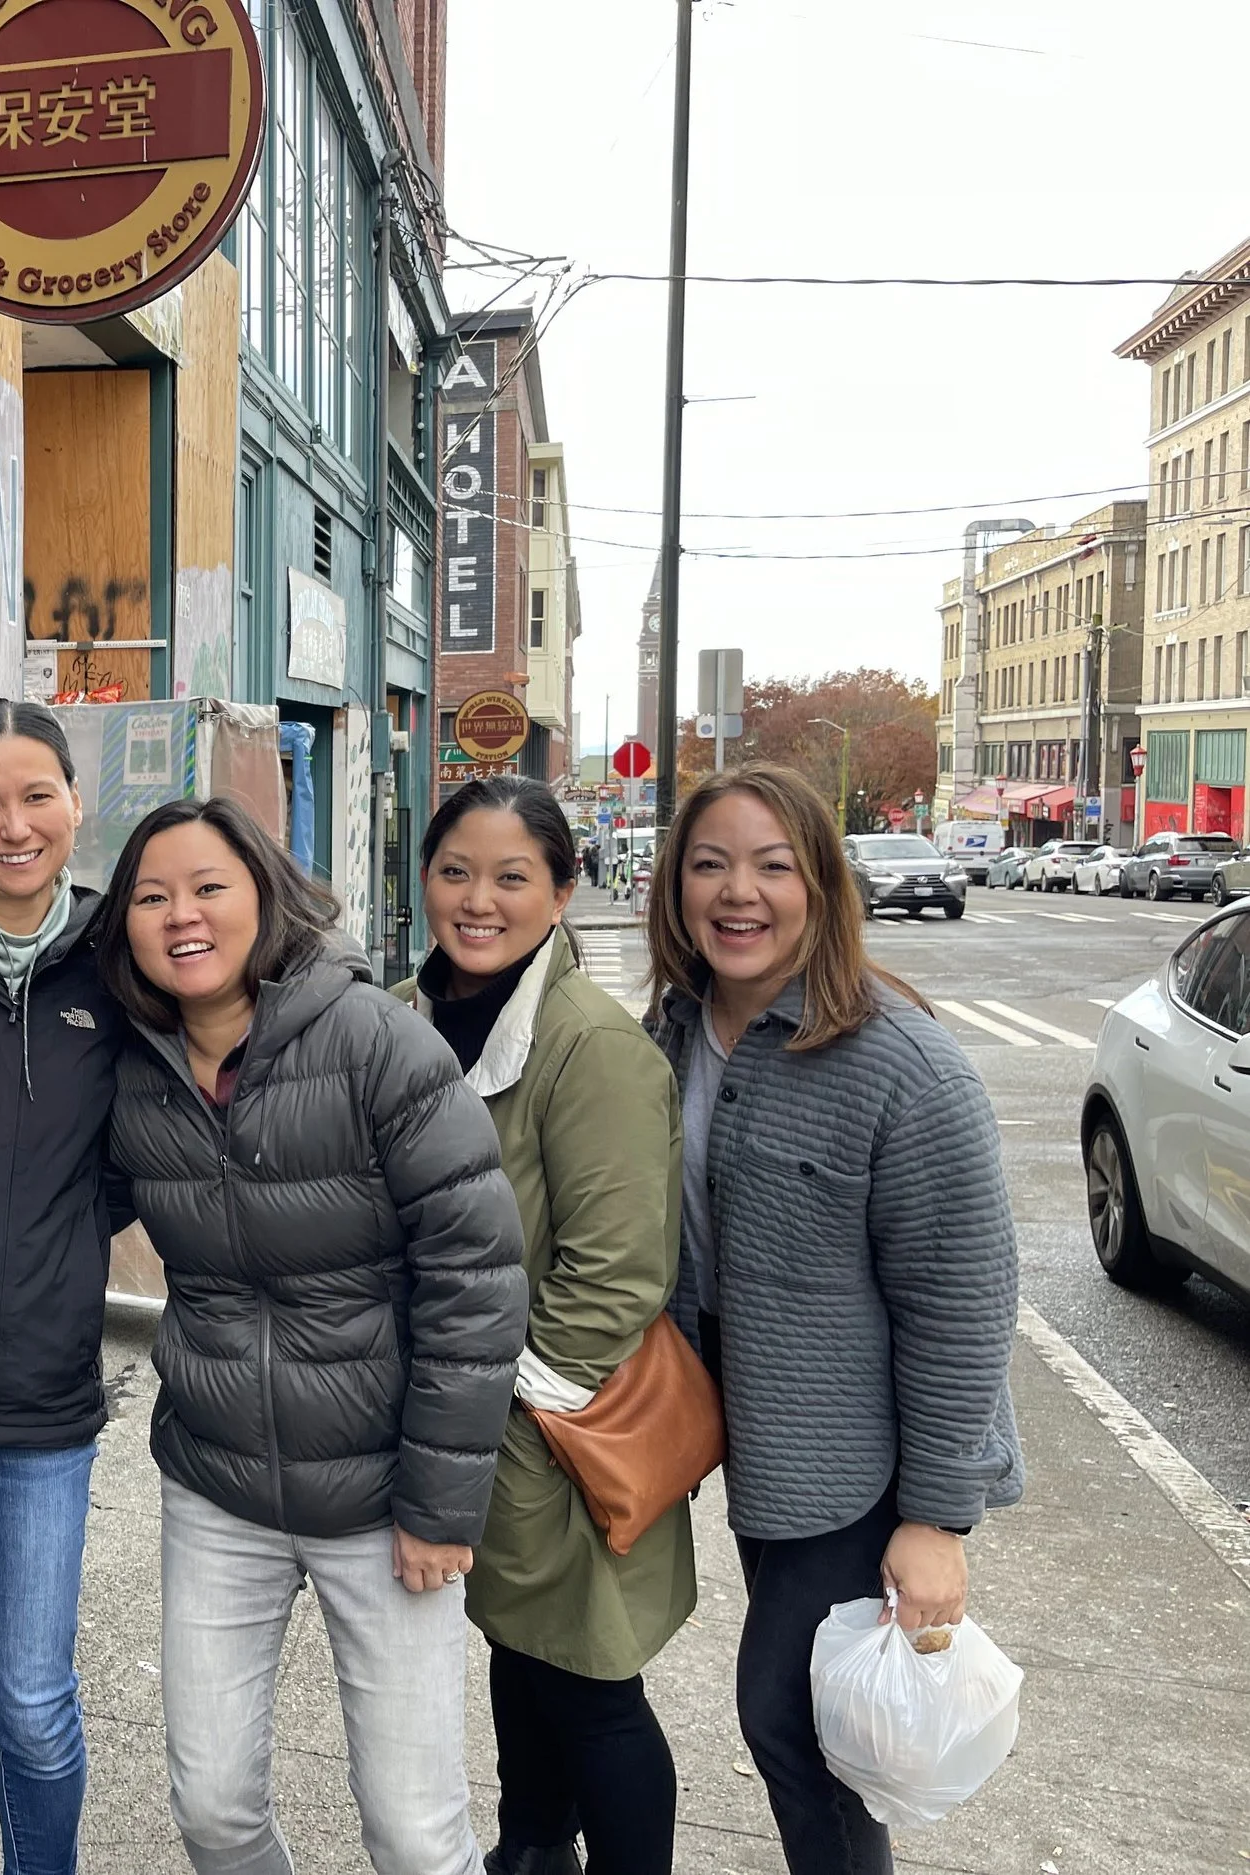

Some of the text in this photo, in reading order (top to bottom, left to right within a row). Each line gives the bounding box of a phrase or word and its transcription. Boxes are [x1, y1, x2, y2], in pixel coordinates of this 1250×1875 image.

[18, 250, 143, 296] Grocery
[146, 181, 211, 257] Store
[444, 422, 482, 638] HOTEL
[463, 699, 486, 718] WORLD
[475, 750, 509, 760] STATION
[60, 1011, 83, 1021] NORTH
[71, 1007, 84, 1016] THE
